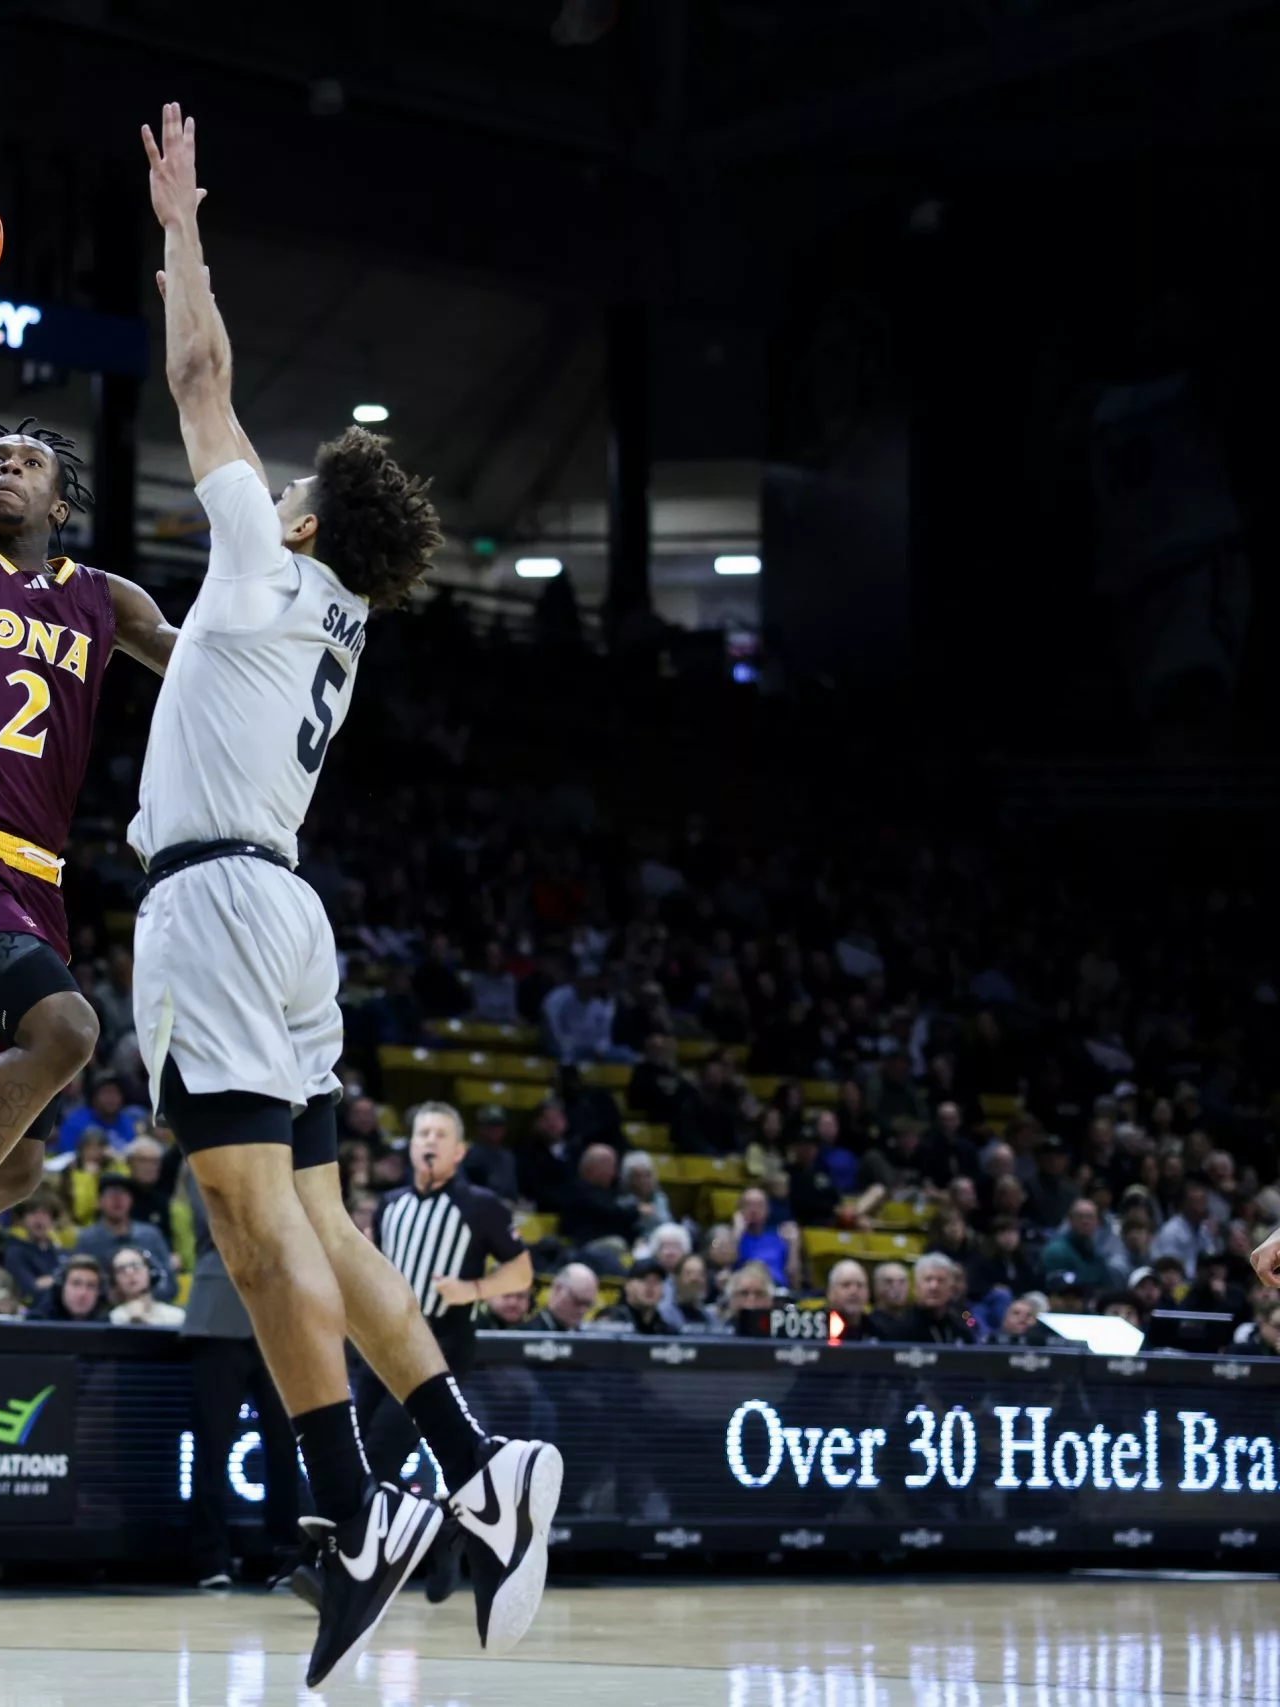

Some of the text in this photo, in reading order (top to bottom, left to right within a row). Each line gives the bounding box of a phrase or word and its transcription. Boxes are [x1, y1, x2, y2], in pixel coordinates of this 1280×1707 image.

[297, 647, 347, 774] 5
[770, 1308, 827, 1338] POSS
[726, 1399, 1280, 1491] Over 30 Hotel Bra
